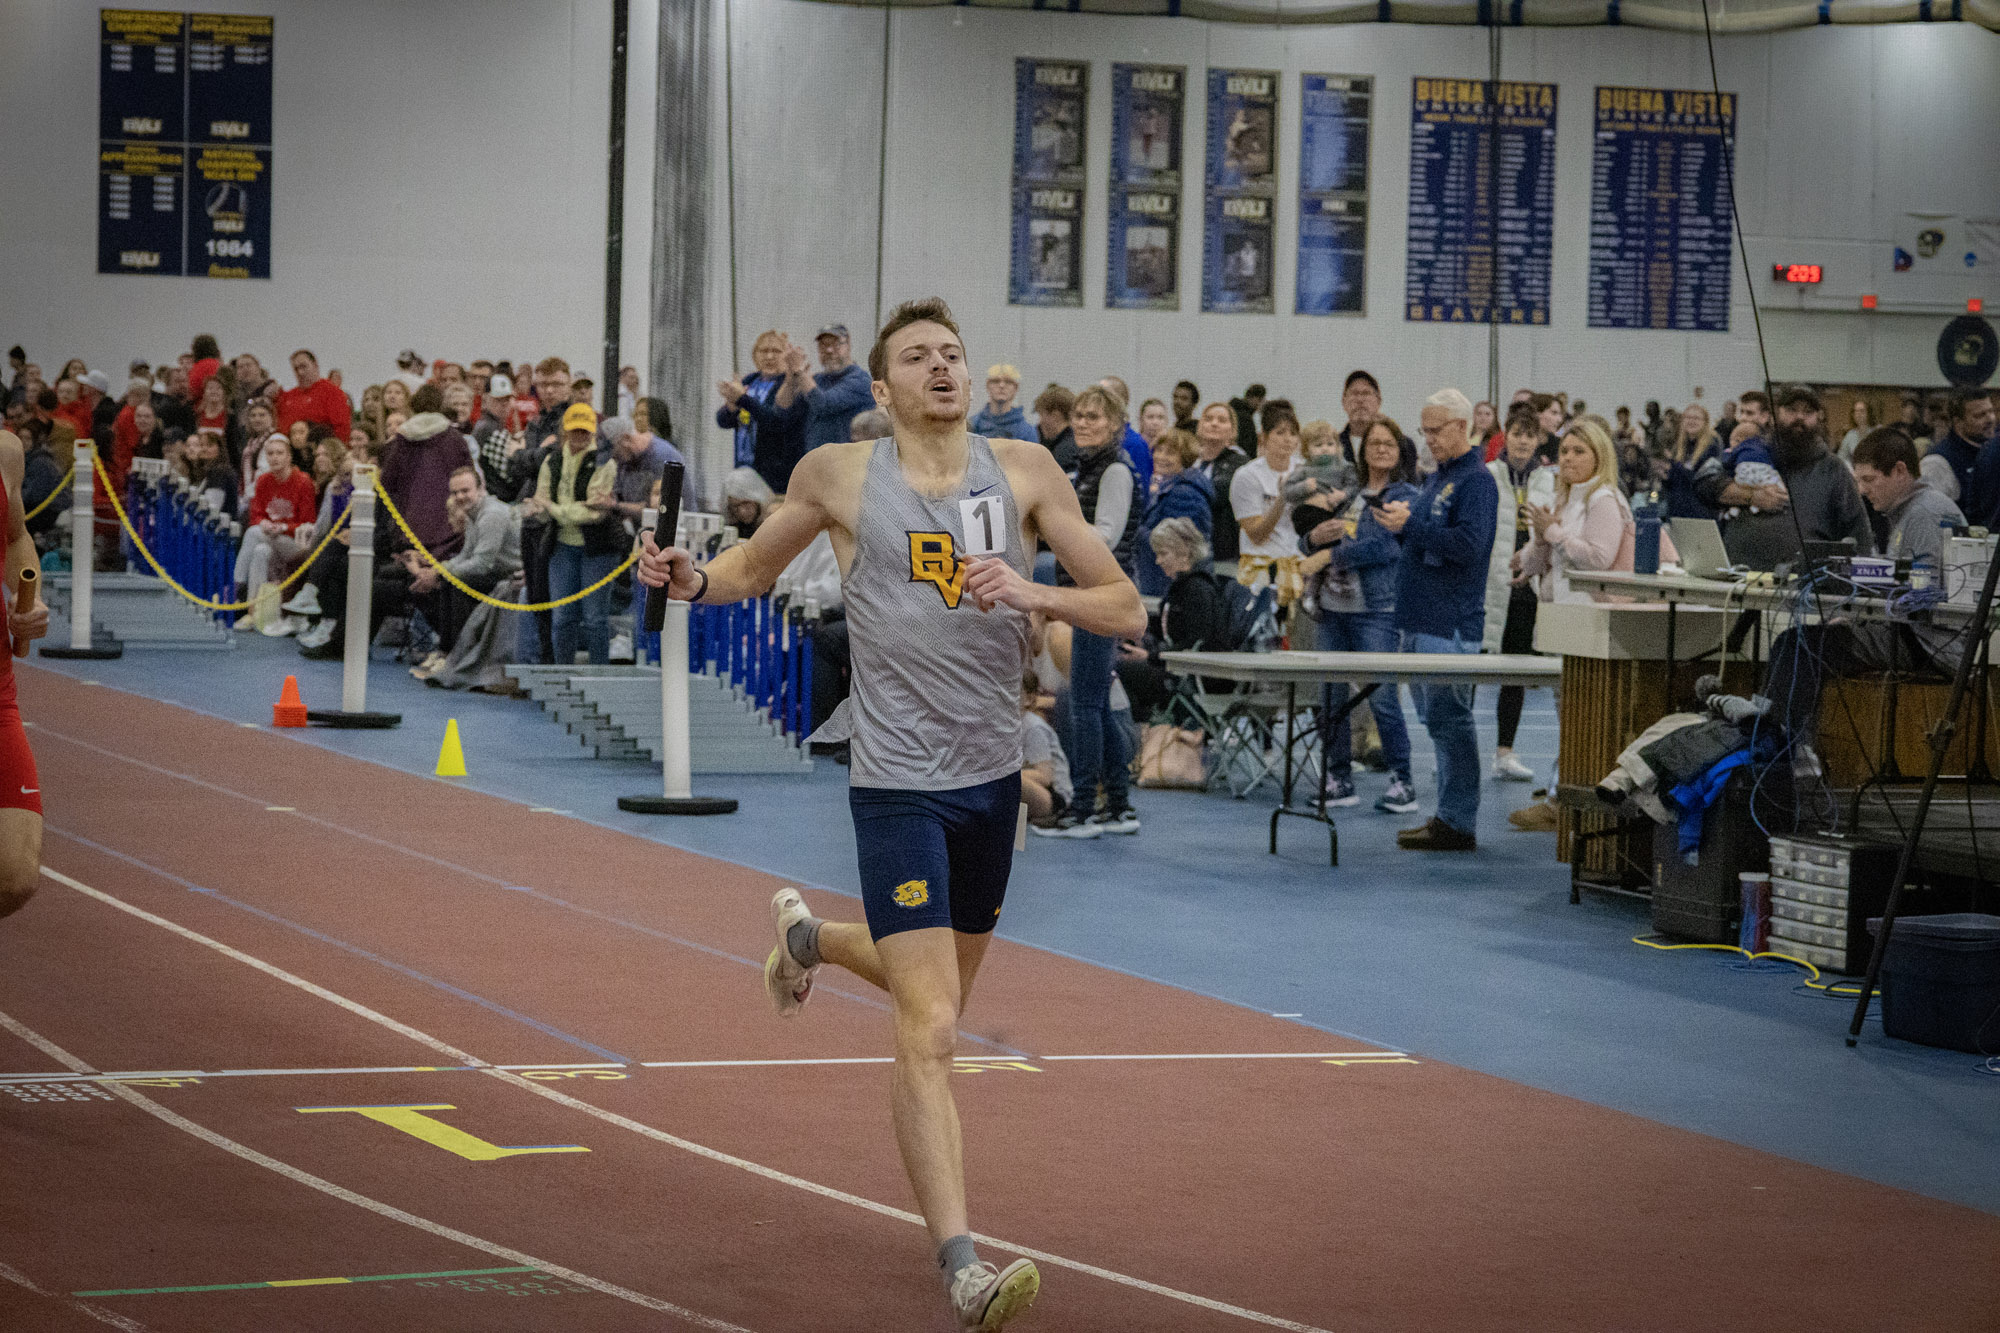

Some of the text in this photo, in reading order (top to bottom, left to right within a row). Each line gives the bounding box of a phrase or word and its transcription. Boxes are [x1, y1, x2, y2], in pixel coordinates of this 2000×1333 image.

[1416, 80, 1553, 106] BUENA VISTA
[1598, 89, 1732, 115] BUENA VISTA
[971, 500, 993, 551] 1
[293, 1103, 591, 1161] 1
